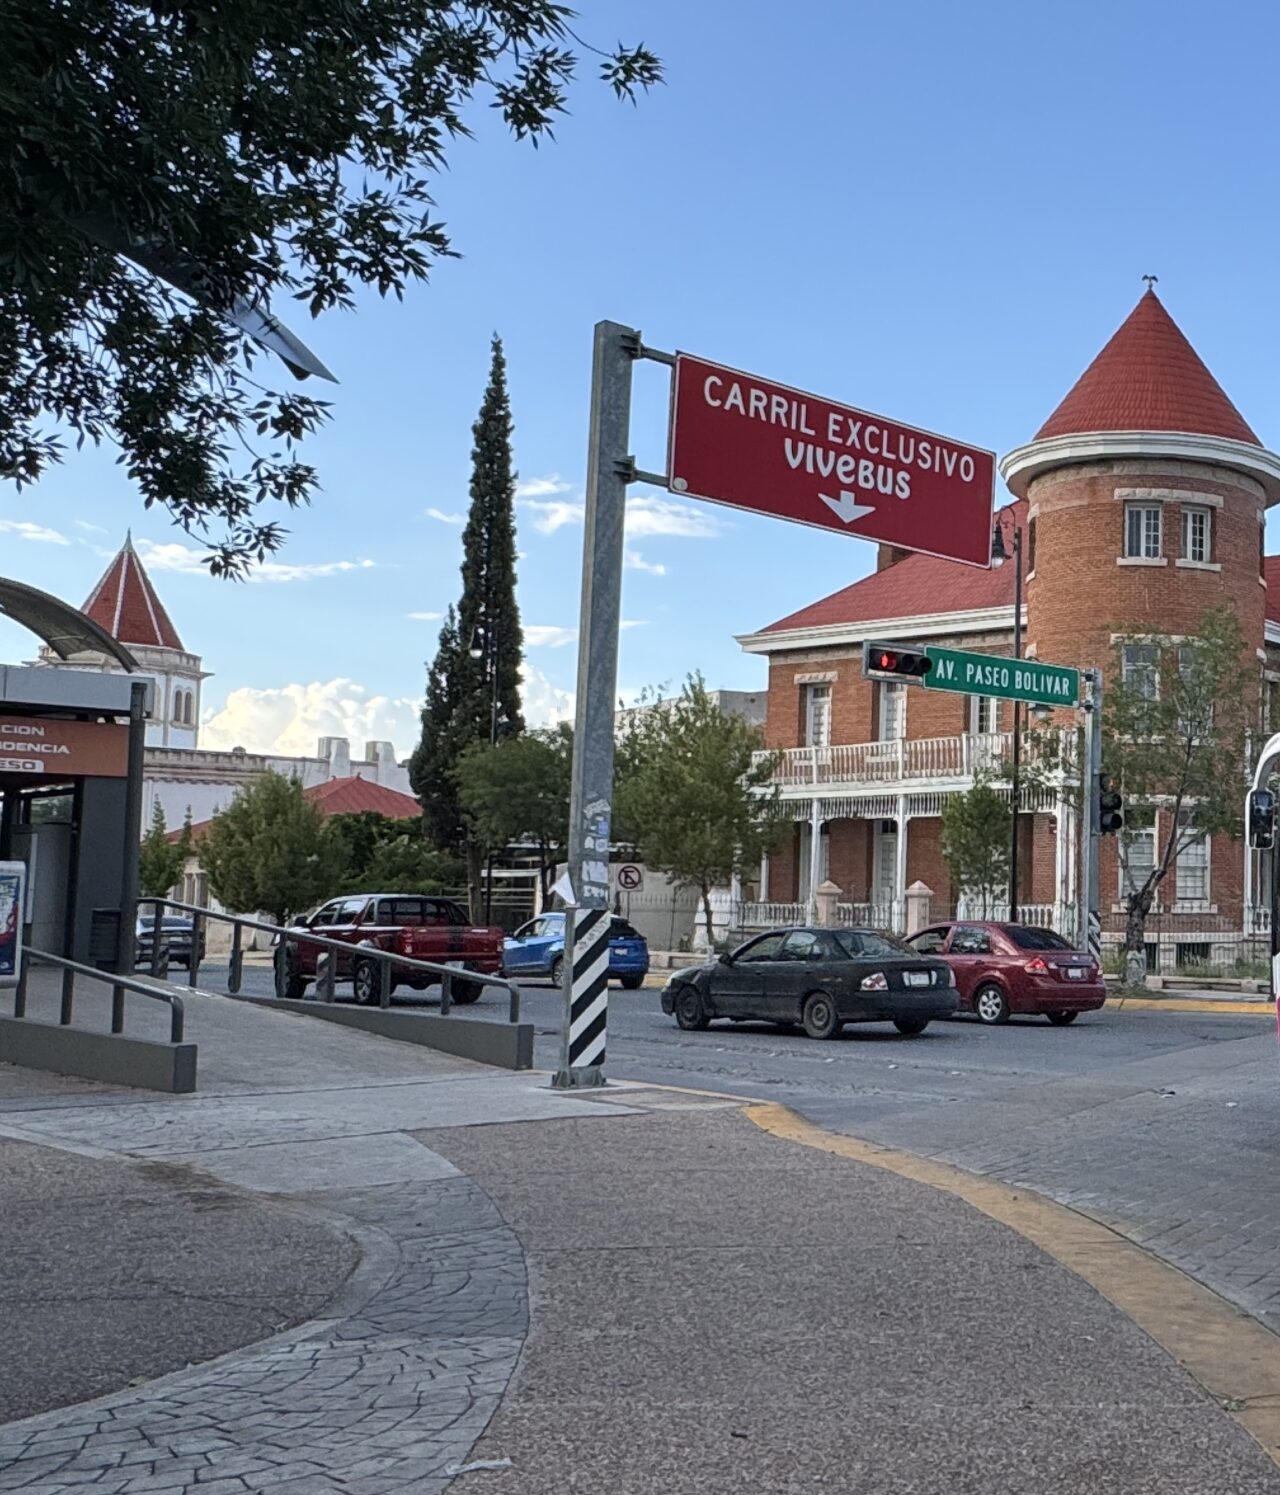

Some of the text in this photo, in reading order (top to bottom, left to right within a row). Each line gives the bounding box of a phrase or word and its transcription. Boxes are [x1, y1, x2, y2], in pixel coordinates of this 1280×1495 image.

[703, 375, 975, 482] CARRIL EXCLUSIVO
[936, 659, 1070, 697] AV. PASEO BOLIVAR
[0, 724, 45, 737] CION
[0, 740, 70, 755] DENCIA
